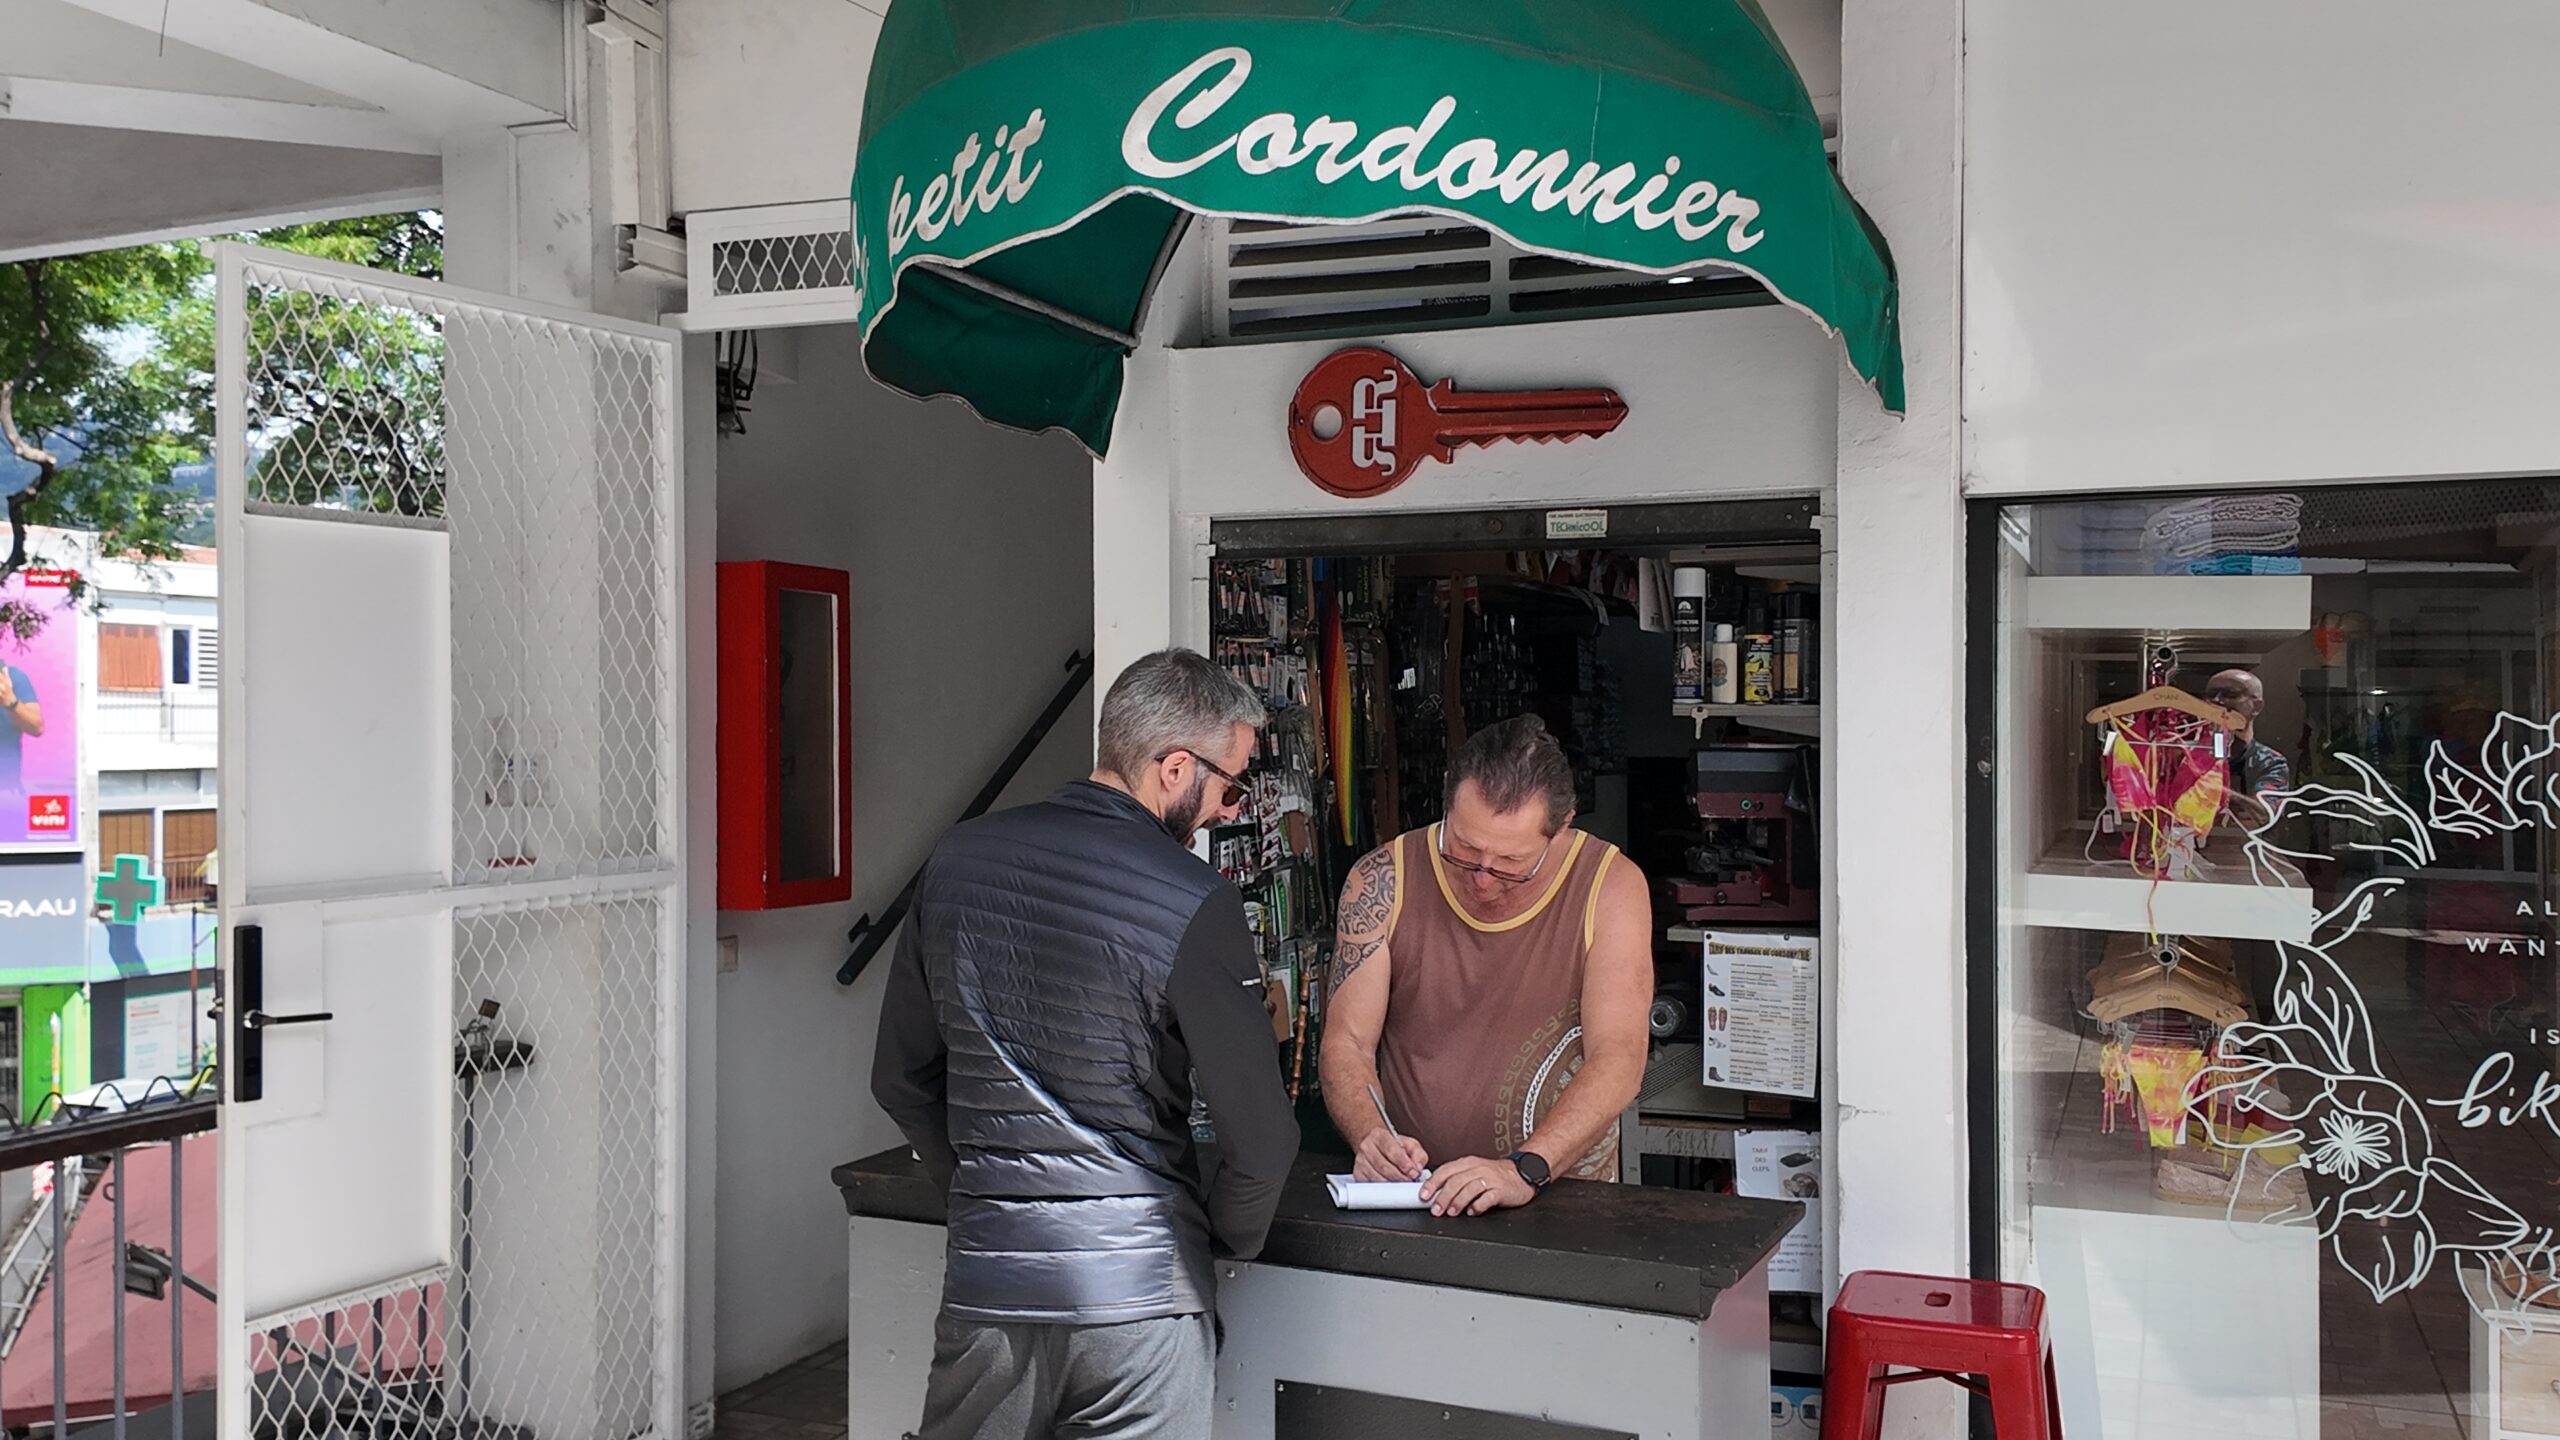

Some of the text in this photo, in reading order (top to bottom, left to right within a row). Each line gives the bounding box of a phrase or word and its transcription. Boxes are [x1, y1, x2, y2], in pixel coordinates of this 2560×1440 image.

[887, 108, 1046, 258] petit
[1121, 46, 1764, 254] Cordonnier
[2516, 901, 2560, 916] AL
[2530, 1028, 2560, 1045] IS
